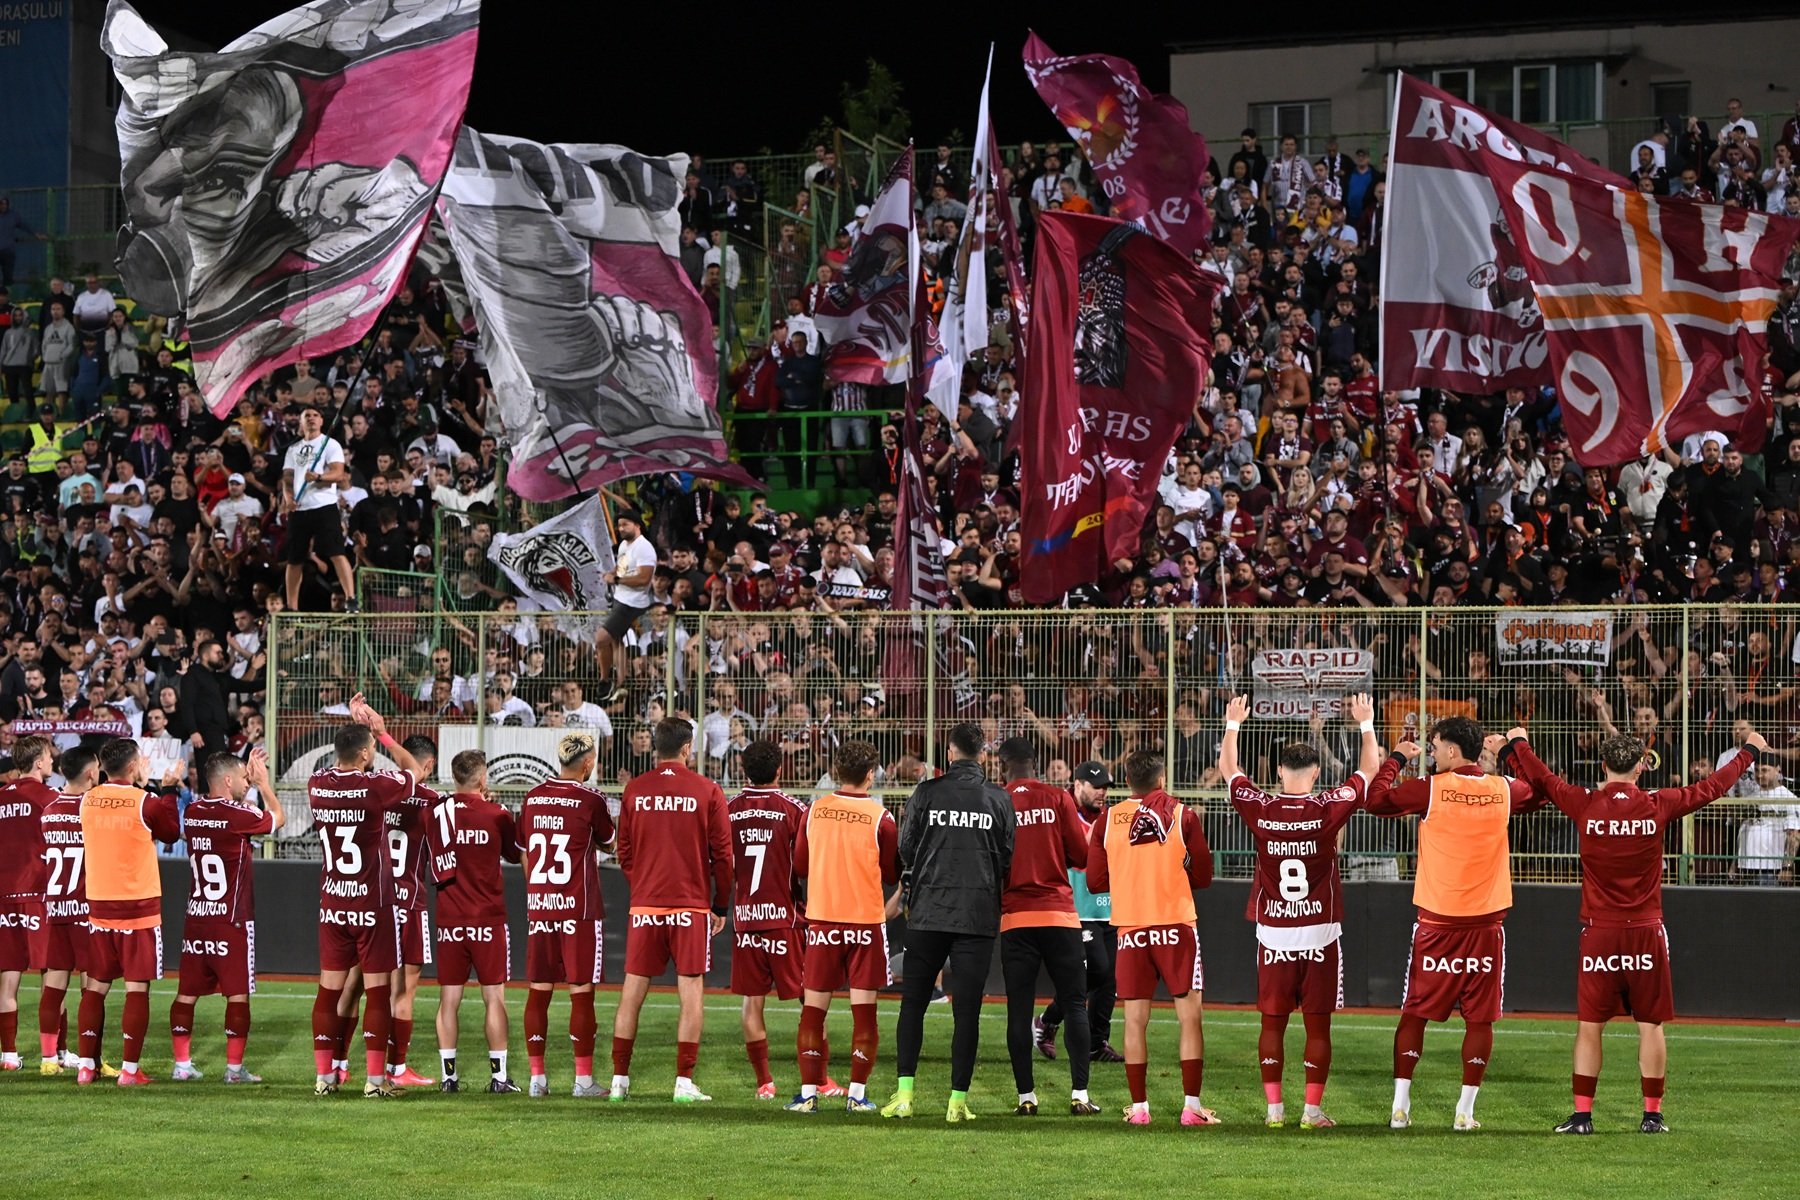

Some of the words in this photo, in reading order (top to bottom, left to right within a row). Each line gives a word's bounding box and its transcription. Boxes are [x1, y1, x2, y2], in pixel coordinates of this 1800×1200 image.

[0, 29, 20, 46] ENI
[830, 584, 888, 600] RADICALS
[1263, 651, 1360, 668] RAPID
[1254, 700, 1342, 716] GIULES
[16, 721, 52, 732] RAPID
[488, 763, 521, 779] PELUZA
[311, 787, 369, 799] MOBEXPERT
[1441, 789, 1504, 806] Kappa
[84, 796, 135, 809] Kappa
[527, 797, 582, 809] MOBEXPERT
[635, 796, 651, 811] FC
[654, 796, 697, 812] RAPID
[0, 803, 32, 820] RAPID
[729, 809, 786, 822] MOBEXPERT
[814, 806, 872, 825] Kappa
[929, 810, 946, 826] FC
[949, 810, 993, 830] RAPID
[1014, 808, 1056, 827] RAPID
[184, 818, 229, 829] OBEXPERT
[533, 815, 564, 830] MANEA
[1257, 818, 1323, 831] MOBEXPERT
[1586, 819, 1605, 835] FC
[1608, 819, 1657, 835] RAPID
[456, 829, 489, 845] APID
[319, 825, 363, 875] 13
[1267, 840, 1317, 856] GRAMENI
[528, 833, 572, 885] 23
[46, 846, 85, 896] 27
[190, 853, 228, 901] 19
[744, 844, 767, 897] 7
[1279, 858, 1310, 902] 8
[0, 912, 41, 931] ACRIS
[320, 908, 376, 927] DACRIS
[632, 911, 692, 928] DACRIS
[437, 926, 493, 942] DACRIS
[809, 929, 872, 946] DACRIS
[1117, 928, 1179, 950] DACRIS
[1264, 947, 1325, 966] DACRIS
[1582, 953, 1654, 973] DACRIS
